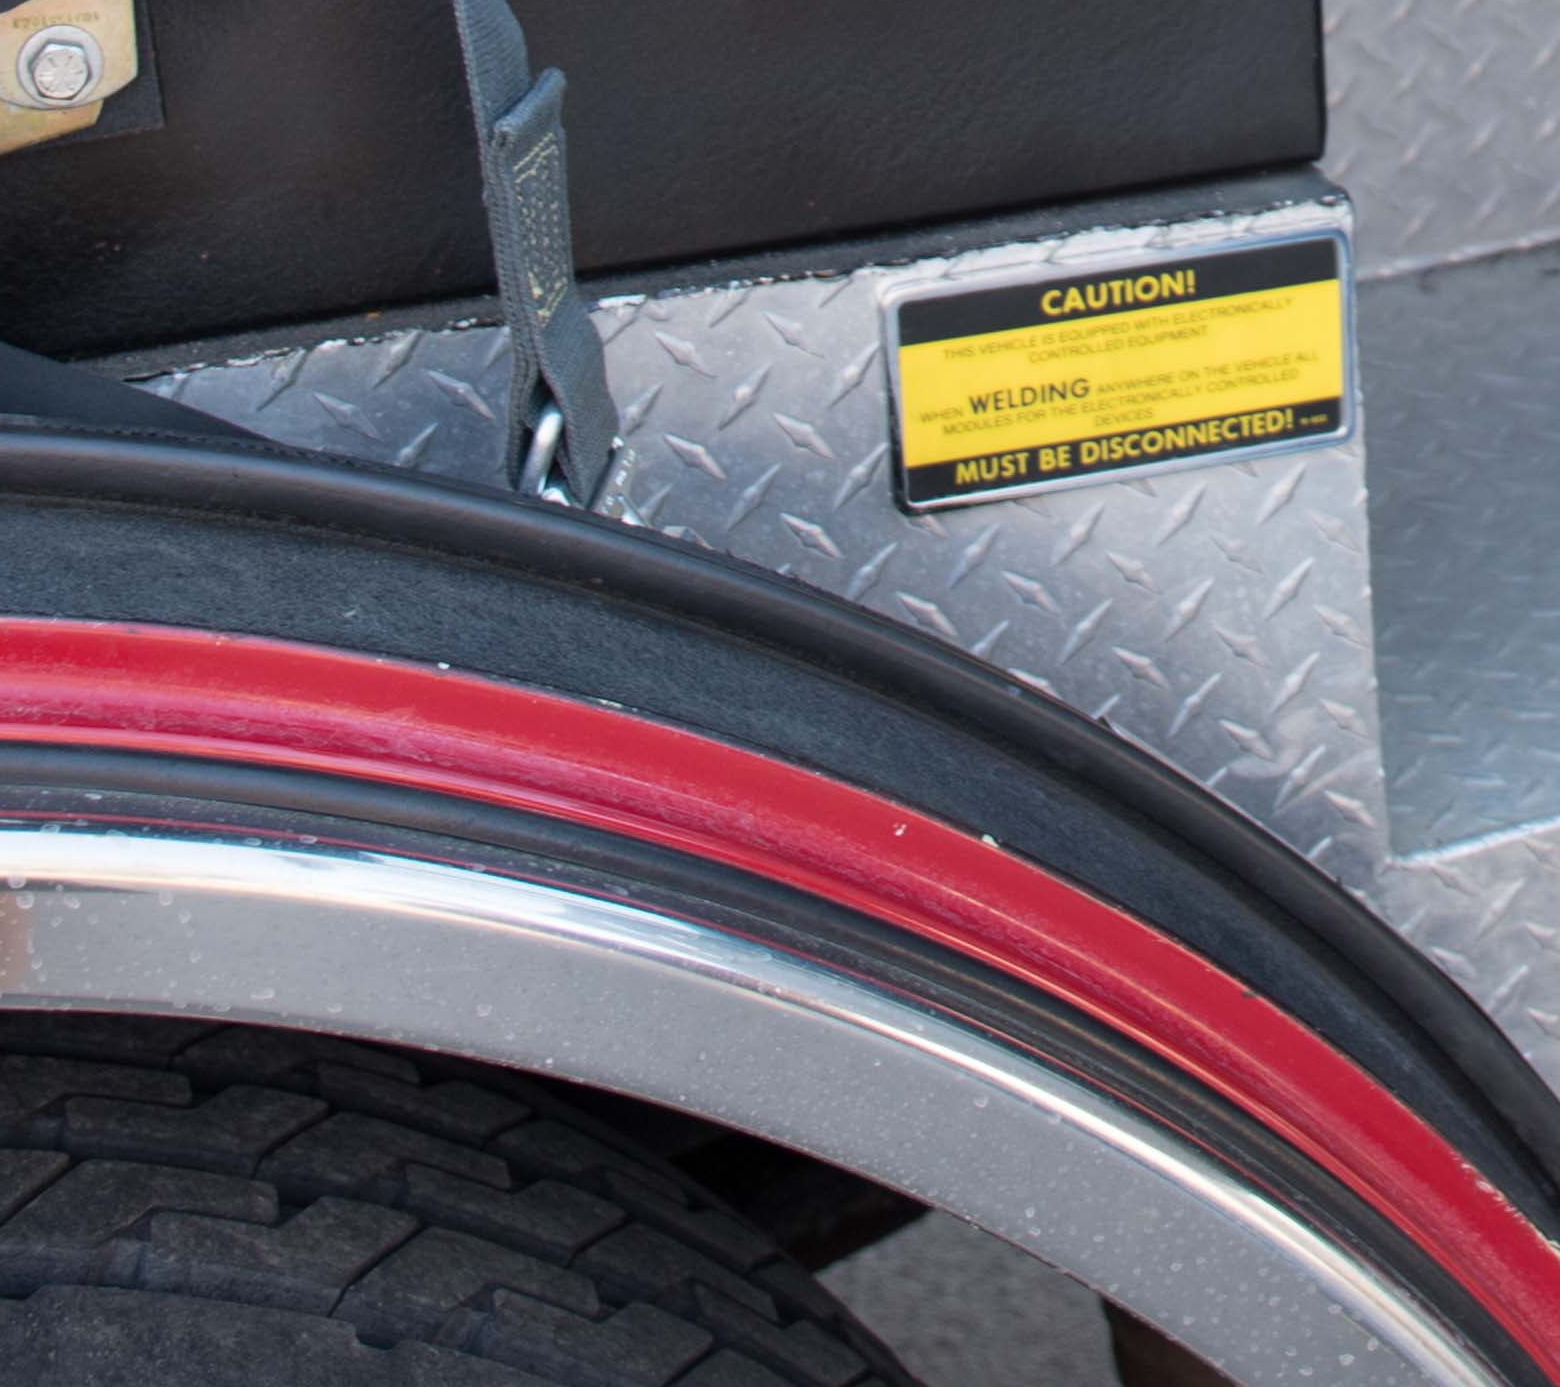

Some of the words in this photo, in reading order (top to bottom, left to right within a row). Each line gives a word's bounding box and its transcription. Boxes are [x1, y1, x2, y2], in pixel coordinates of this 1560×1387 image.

[1042, 269, 1196, 316] CAUTION!
[944, 345, 976, 360] THIS
[980, 336, 1037, 355] VEHICLE
[1059, 321, 1130, 344] EQUIPPED
[1135, 315, 1169, 329] WITH
[1173, 298, 1293, 324] ELECTRONICALLY
[1028, 338, 1125, 363] CONTROLLED
[1128, 324, 1208, 348] EQUIPMENT
[920, 407, 963, 424] WHEN
[968, 378, 1091, 415] WELDING
[1096, 373, 1173, 394] ANYWHERE
[1236, 353, 1290, 372] VEHICLE
[943, 415, 1012, 434] MODULES
[1016, 409, 1046, 424] FOR
[1051, 403, 1079, 418] THE
[1082, 383, 1202, 413] ELECTRONICALLY
[1206, 367, 1300, 394] CONTROLLED
[1095, 407, 1154, 427] DEVICES
[955, 451, 1030, 486] MUST
[1038, 444, 1072, 472] BE
[1081, 408, 1294, 465] DISCONNECTED!
